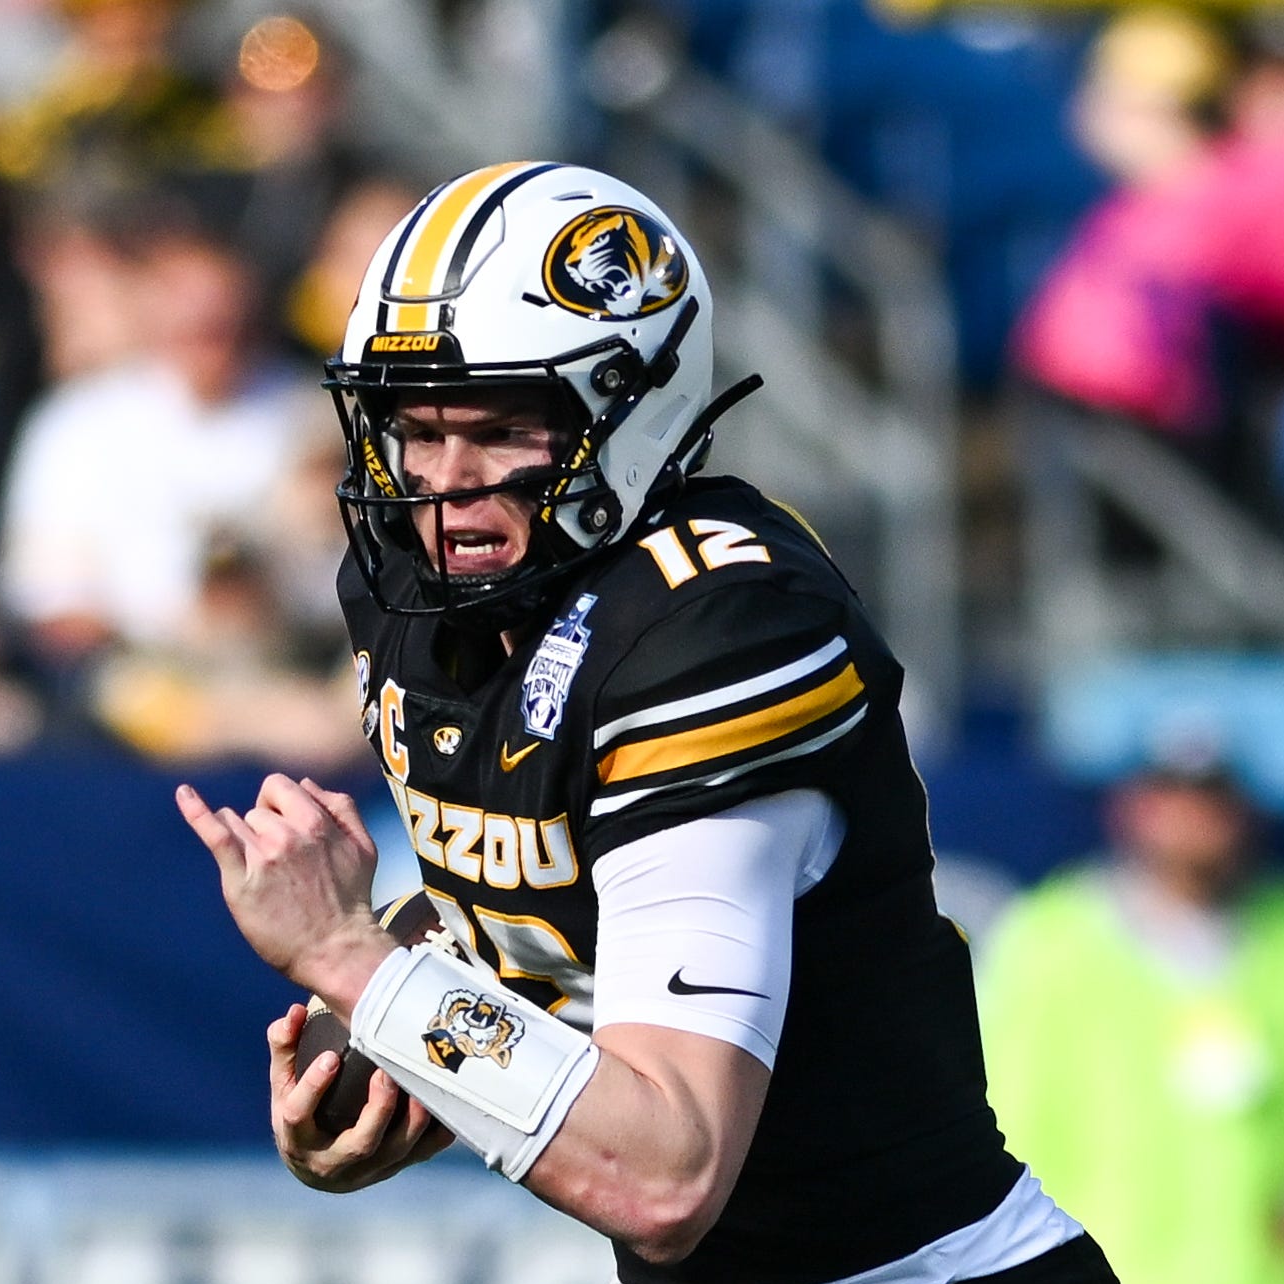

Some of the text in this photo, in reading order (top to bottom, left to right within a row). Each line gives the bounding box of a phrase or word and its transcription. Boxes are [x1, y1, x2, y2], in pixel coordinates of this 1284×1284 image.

[371, 335, 441, 352] MIZZOU
[637, 518, 771, 590] 12
[380, 677, 411, 785] C
